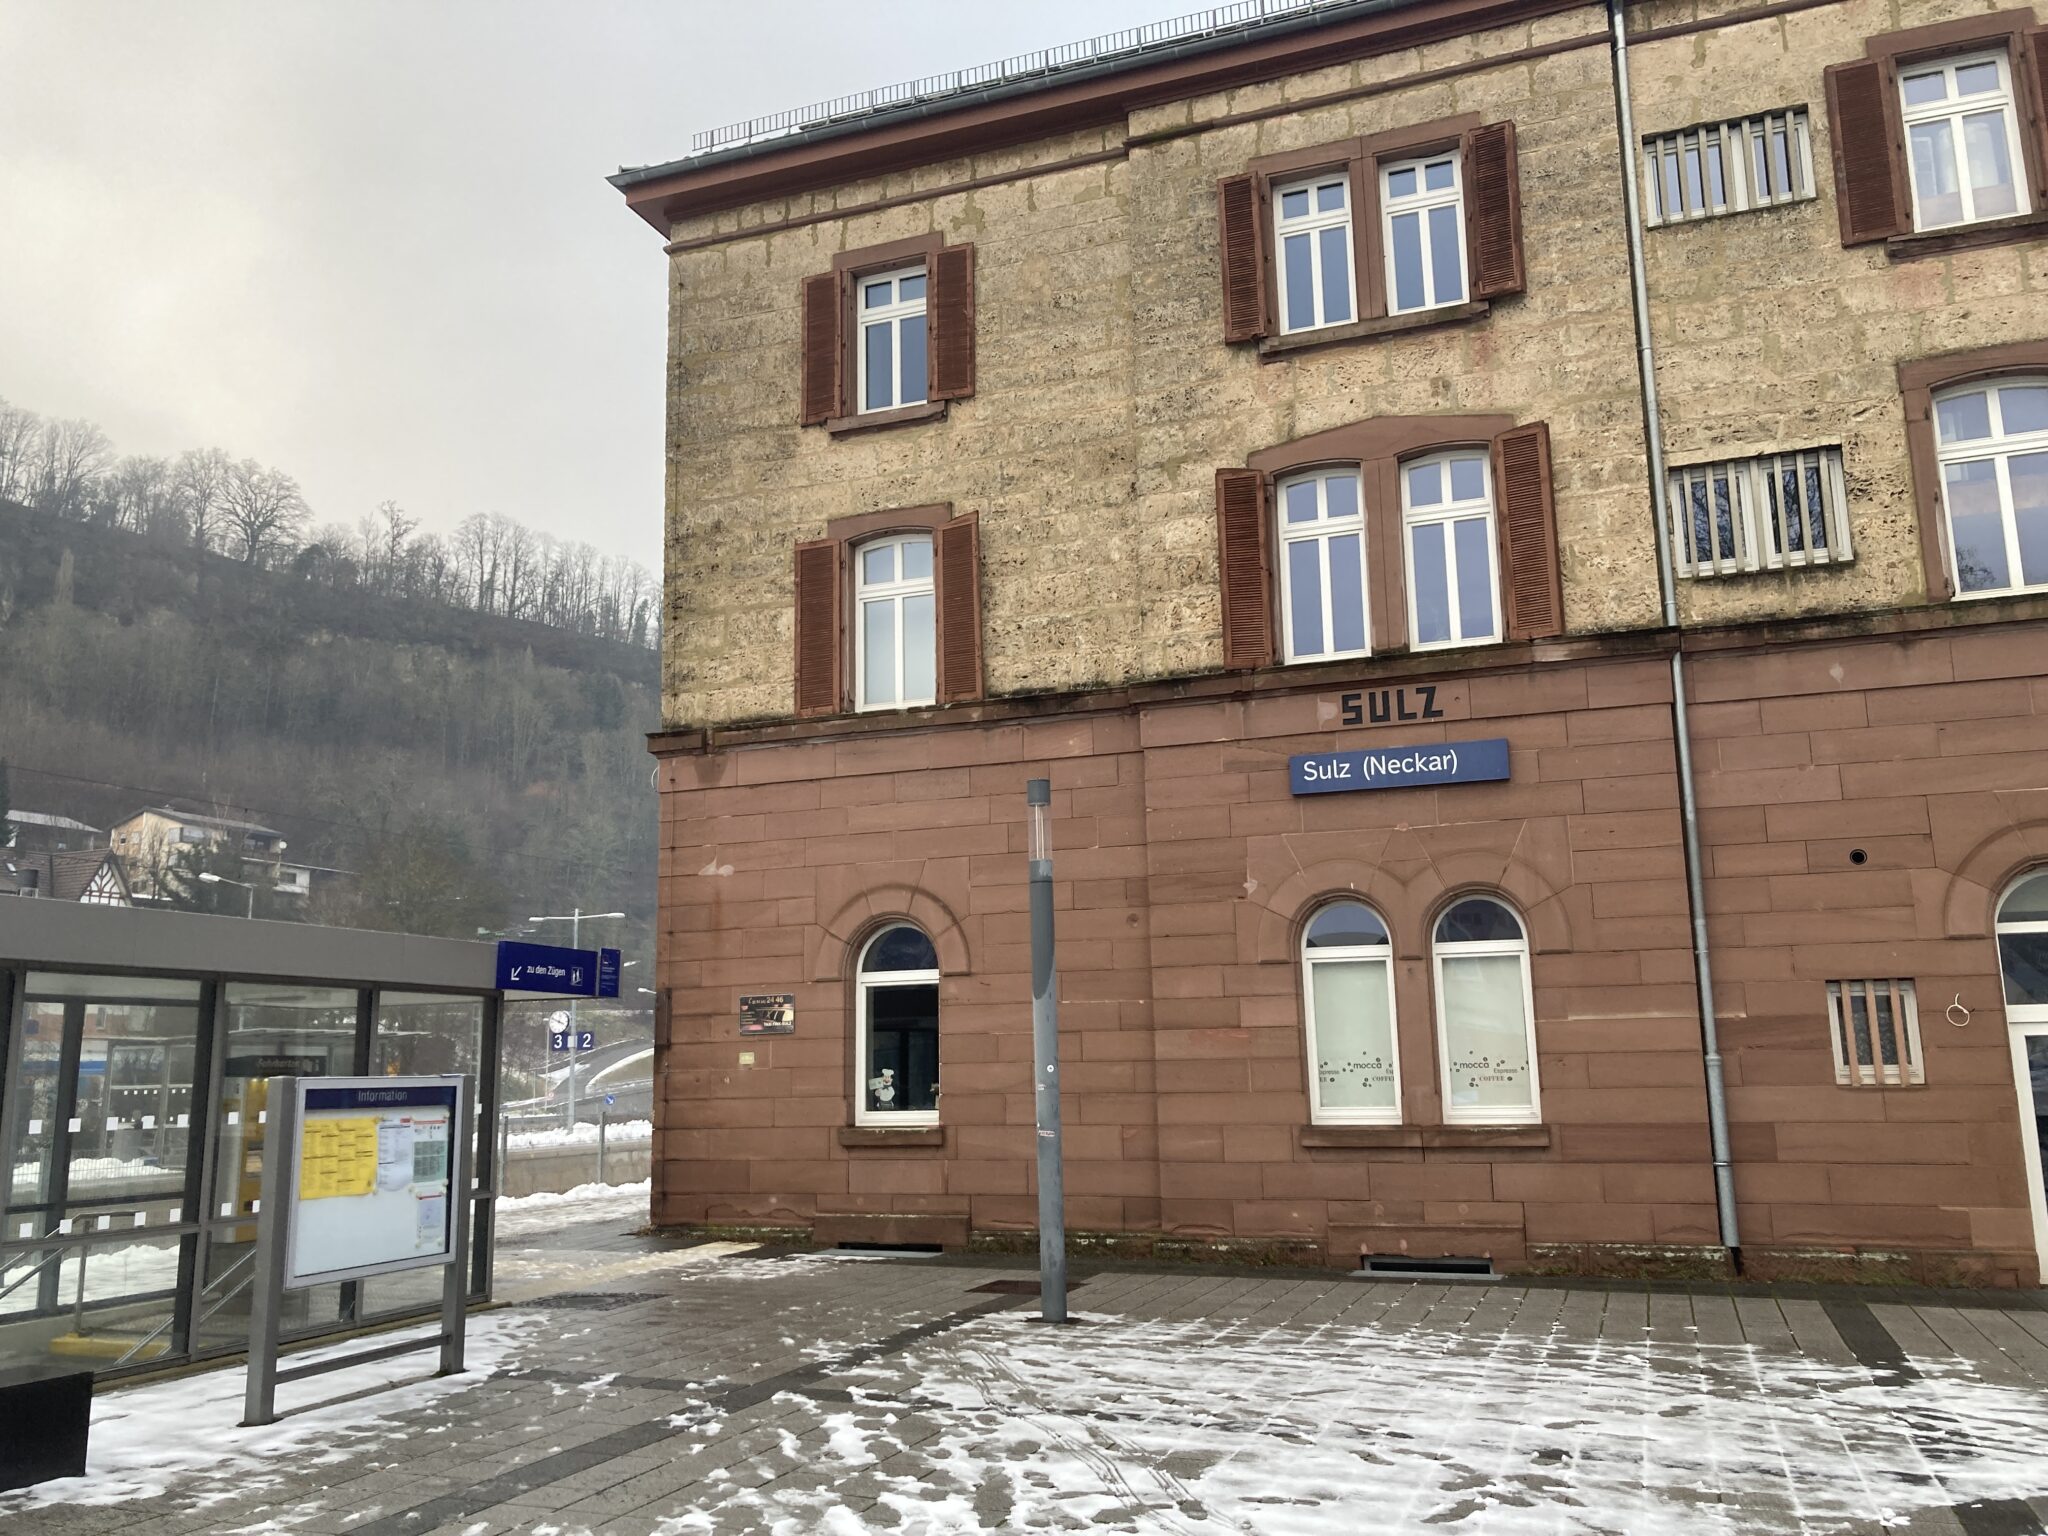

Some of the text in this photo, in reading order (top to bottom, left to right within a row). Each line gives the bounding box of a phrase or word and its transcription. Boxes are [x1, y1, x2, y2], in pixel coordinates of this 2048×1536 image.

[1342, 686, 1443, 725] SULZ
[1303, 749, 1458, 781] Sulz (Neckar)
[527, 965, 565, 977] zu den Zügen
[554, 1034, 562, 1048] 3
[583, 1033, 591, 1047] 2
[1353, 1062, 1382, 1070] mocca
[358, 1089, 408, 1102] Information
